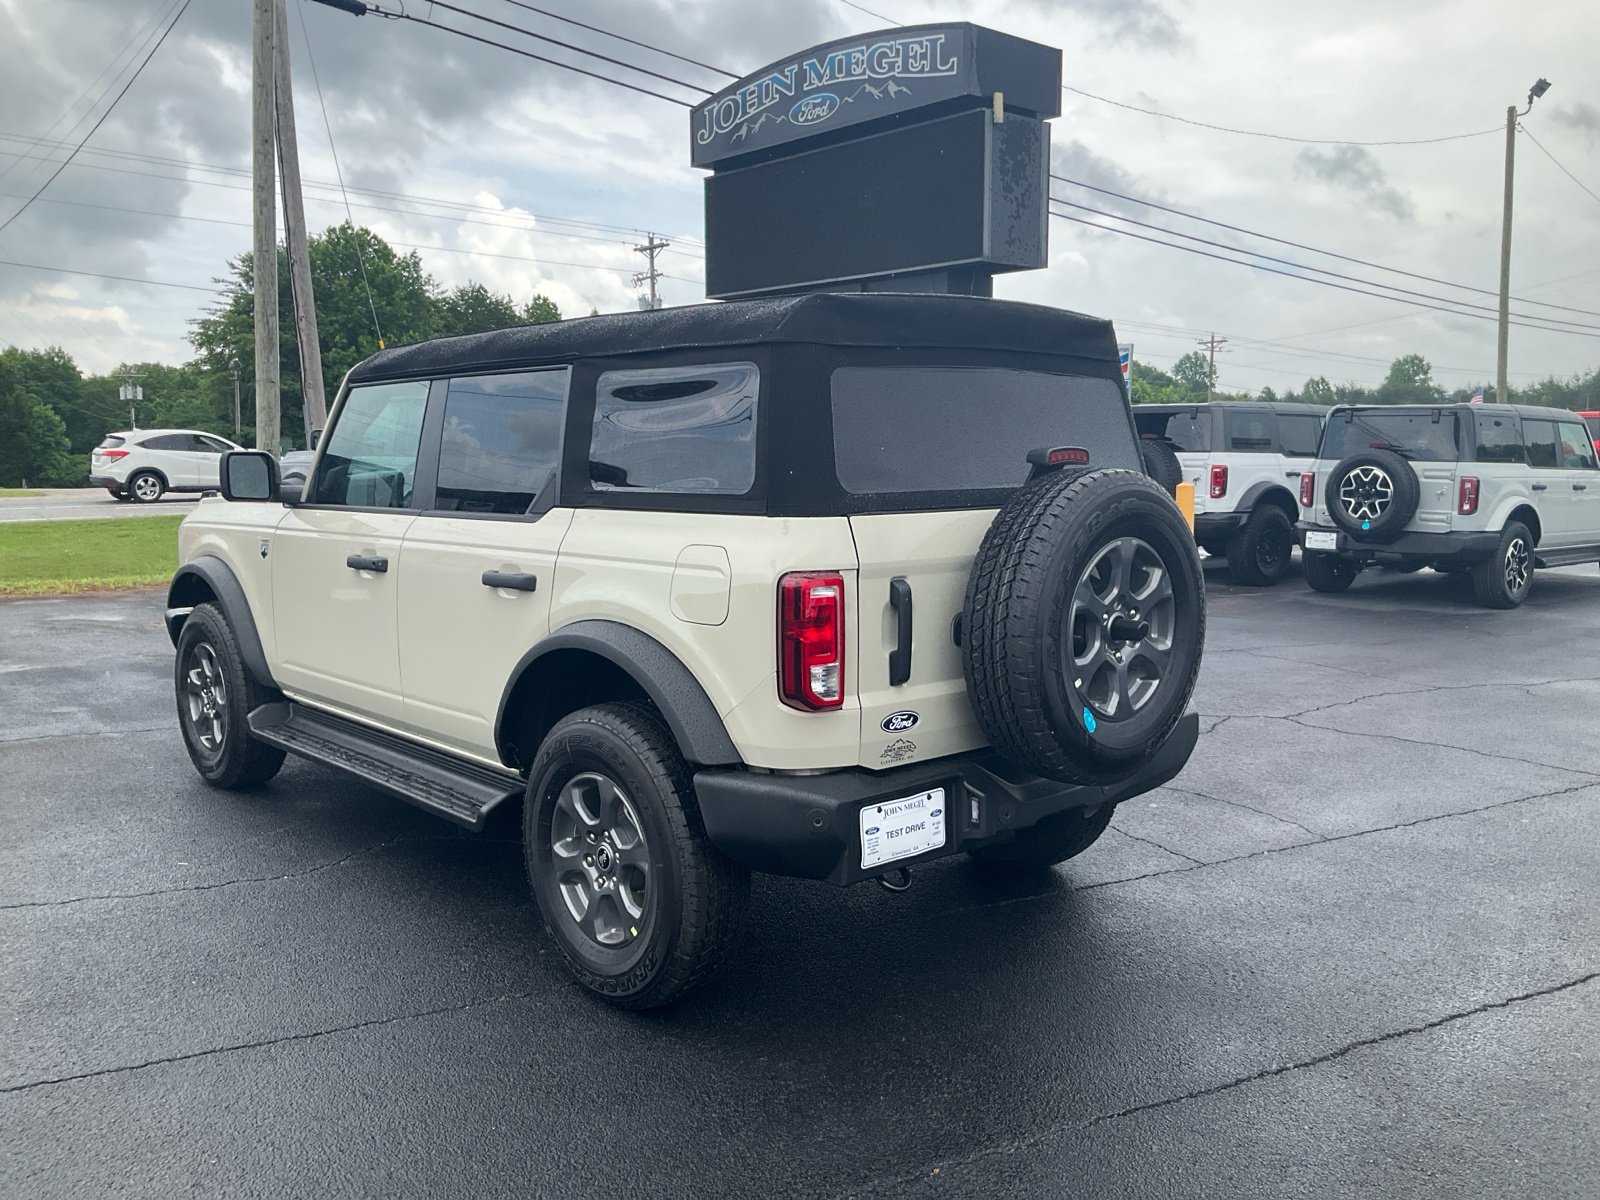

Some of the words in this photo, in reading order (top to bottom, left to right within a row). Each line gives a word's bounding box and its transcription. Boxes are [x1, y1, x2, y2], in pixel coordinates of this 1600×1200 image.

[697, 64, 798, 145] JOHN
[803, 33, 958, 91] MEGEL
[796, 98, 831, 122] Ford
[888, 714, 914, 730] Ford
[883, 804, 903, 819] JOHN
[903, 799, 926, 811] MEGEL
[886, 827, 904, 840] TEST
[905, 821, 926, 835] DRIVE
